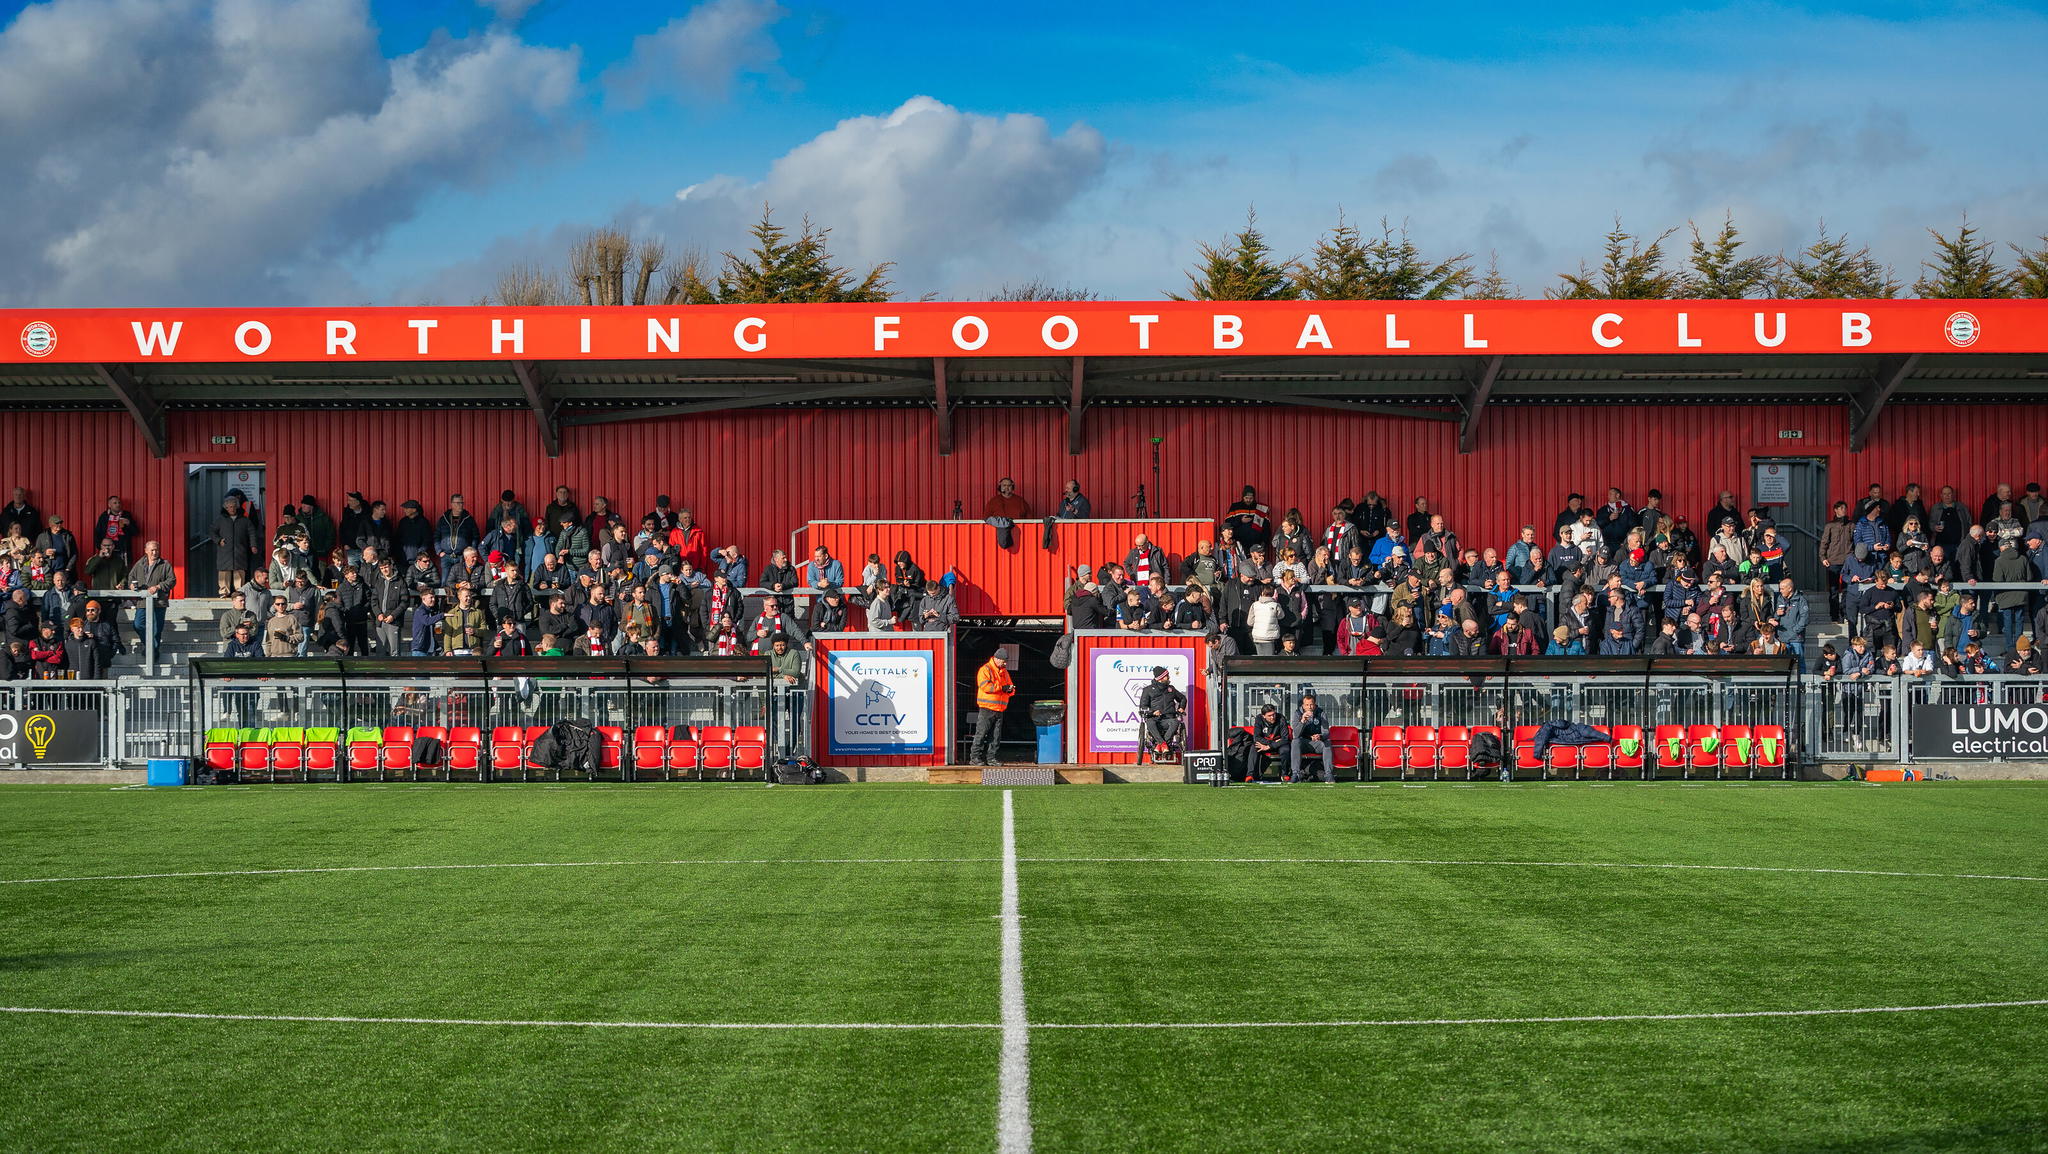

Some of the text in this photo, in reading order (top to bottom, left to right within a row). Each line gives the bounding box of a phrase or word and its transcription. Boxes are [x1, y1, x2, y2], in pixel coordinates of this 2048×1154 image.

[131, 312, 1873, 356] WORTHING FOOTBALL CLUB
[856, 714, 906, 726] CCTV
[1951, 708, 2048, 734] LUMO
[1952, 736, 2048, 754] electrical
